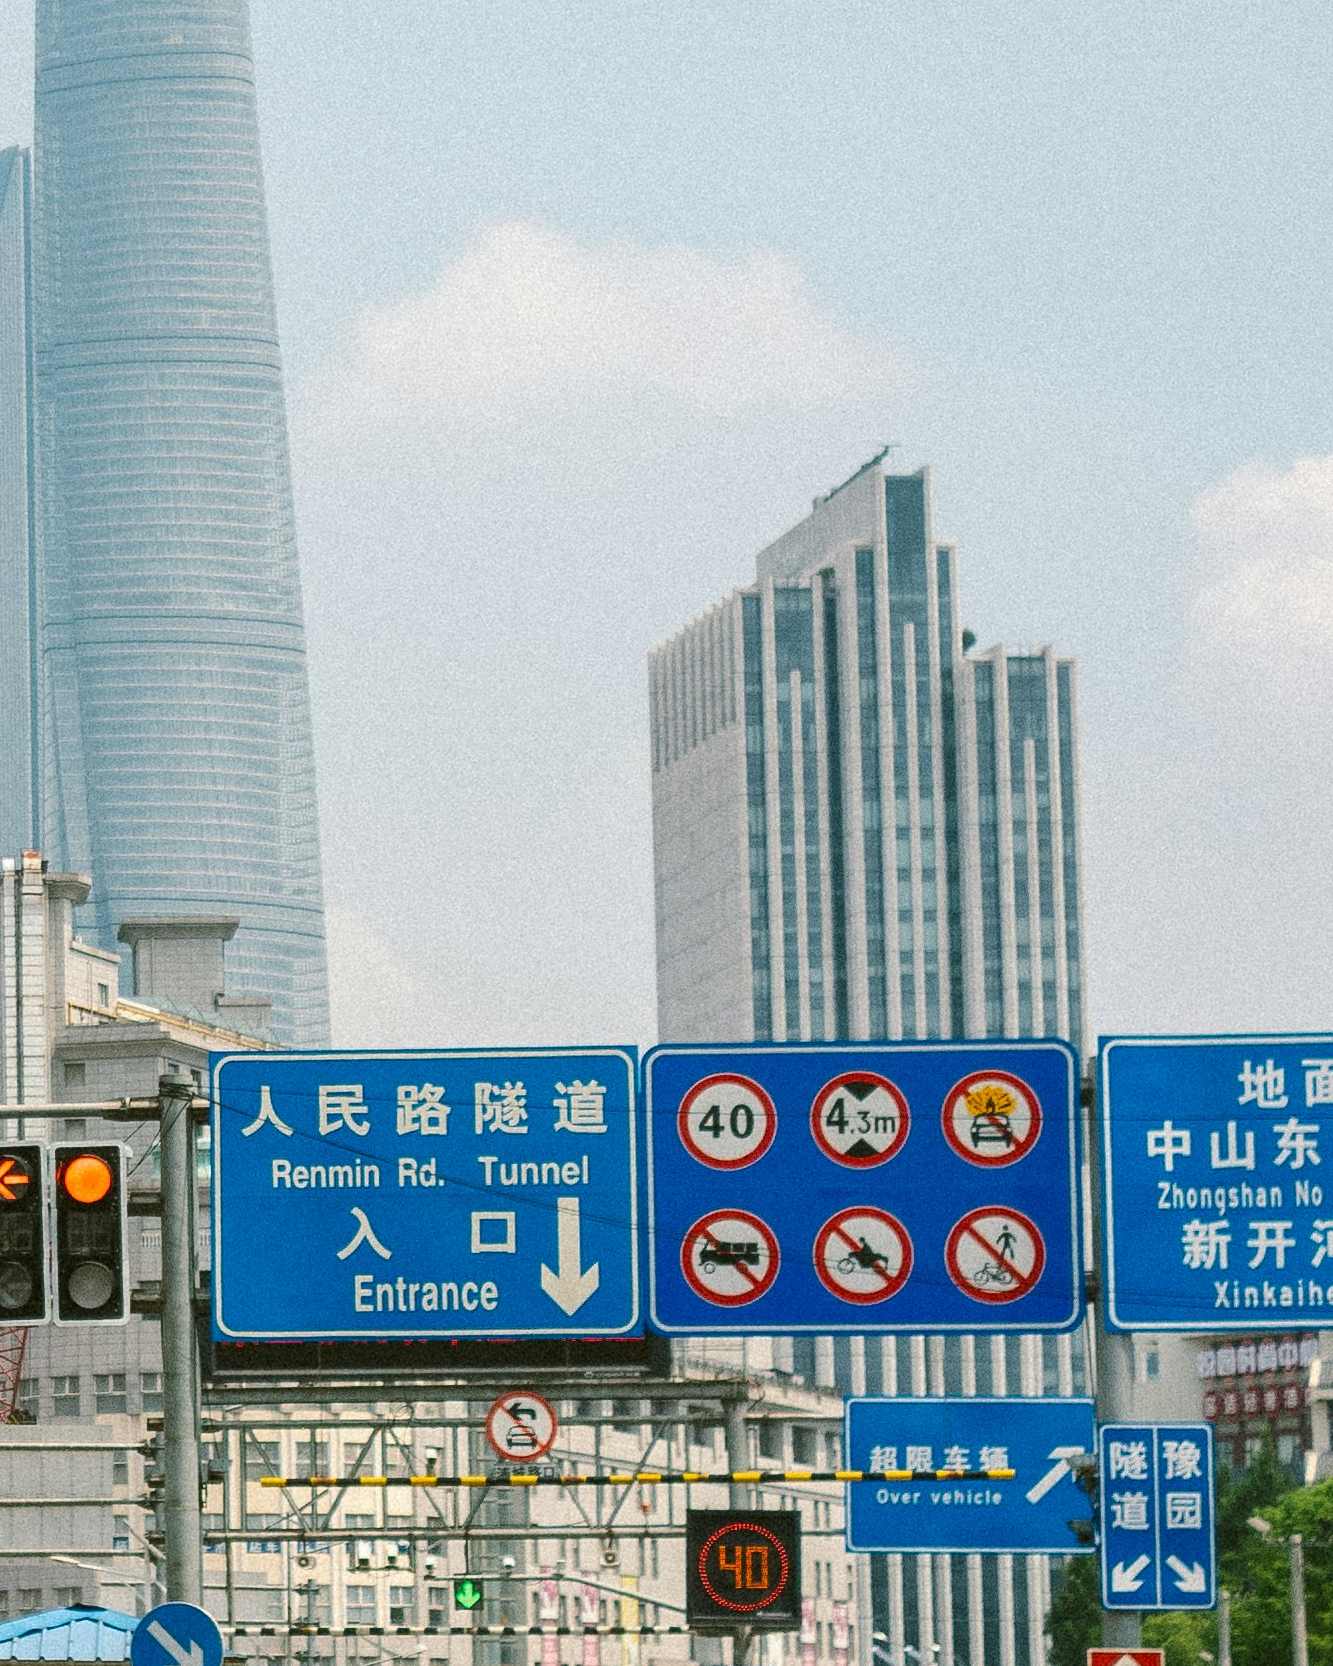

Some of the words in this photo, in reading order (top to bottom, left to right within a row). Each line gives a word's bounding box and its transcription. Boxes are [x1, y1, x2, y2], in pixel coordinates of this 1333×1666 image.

[242, 1080, 609, 1137] 人民路隧道
[699, 1104, 754, 1138] 40
[826, 1097, 896, 1135] 4.3m
[1147, 1117, 1321, 1172] 中山东
[272, 1158, 380, 1189] Renmin
[398, 1157, 445, 1188] Rd.
[478, 1155, 589, 1186] Tunnel
[1158, 1181, 1283, 1216] Zhongshan
[336, 1206, 517, 1260] 入口
[354, 1274, 499, 1313] Entrance
[876, 1488, 921, 1506] Over
[930, 1488, 1003, 1506] vehicle
[1109, 1441, 1150, 1531] 隧道
[1162, 1439, 1203, 1530] 豫园
[719, 1545, 768, 1589] 40
